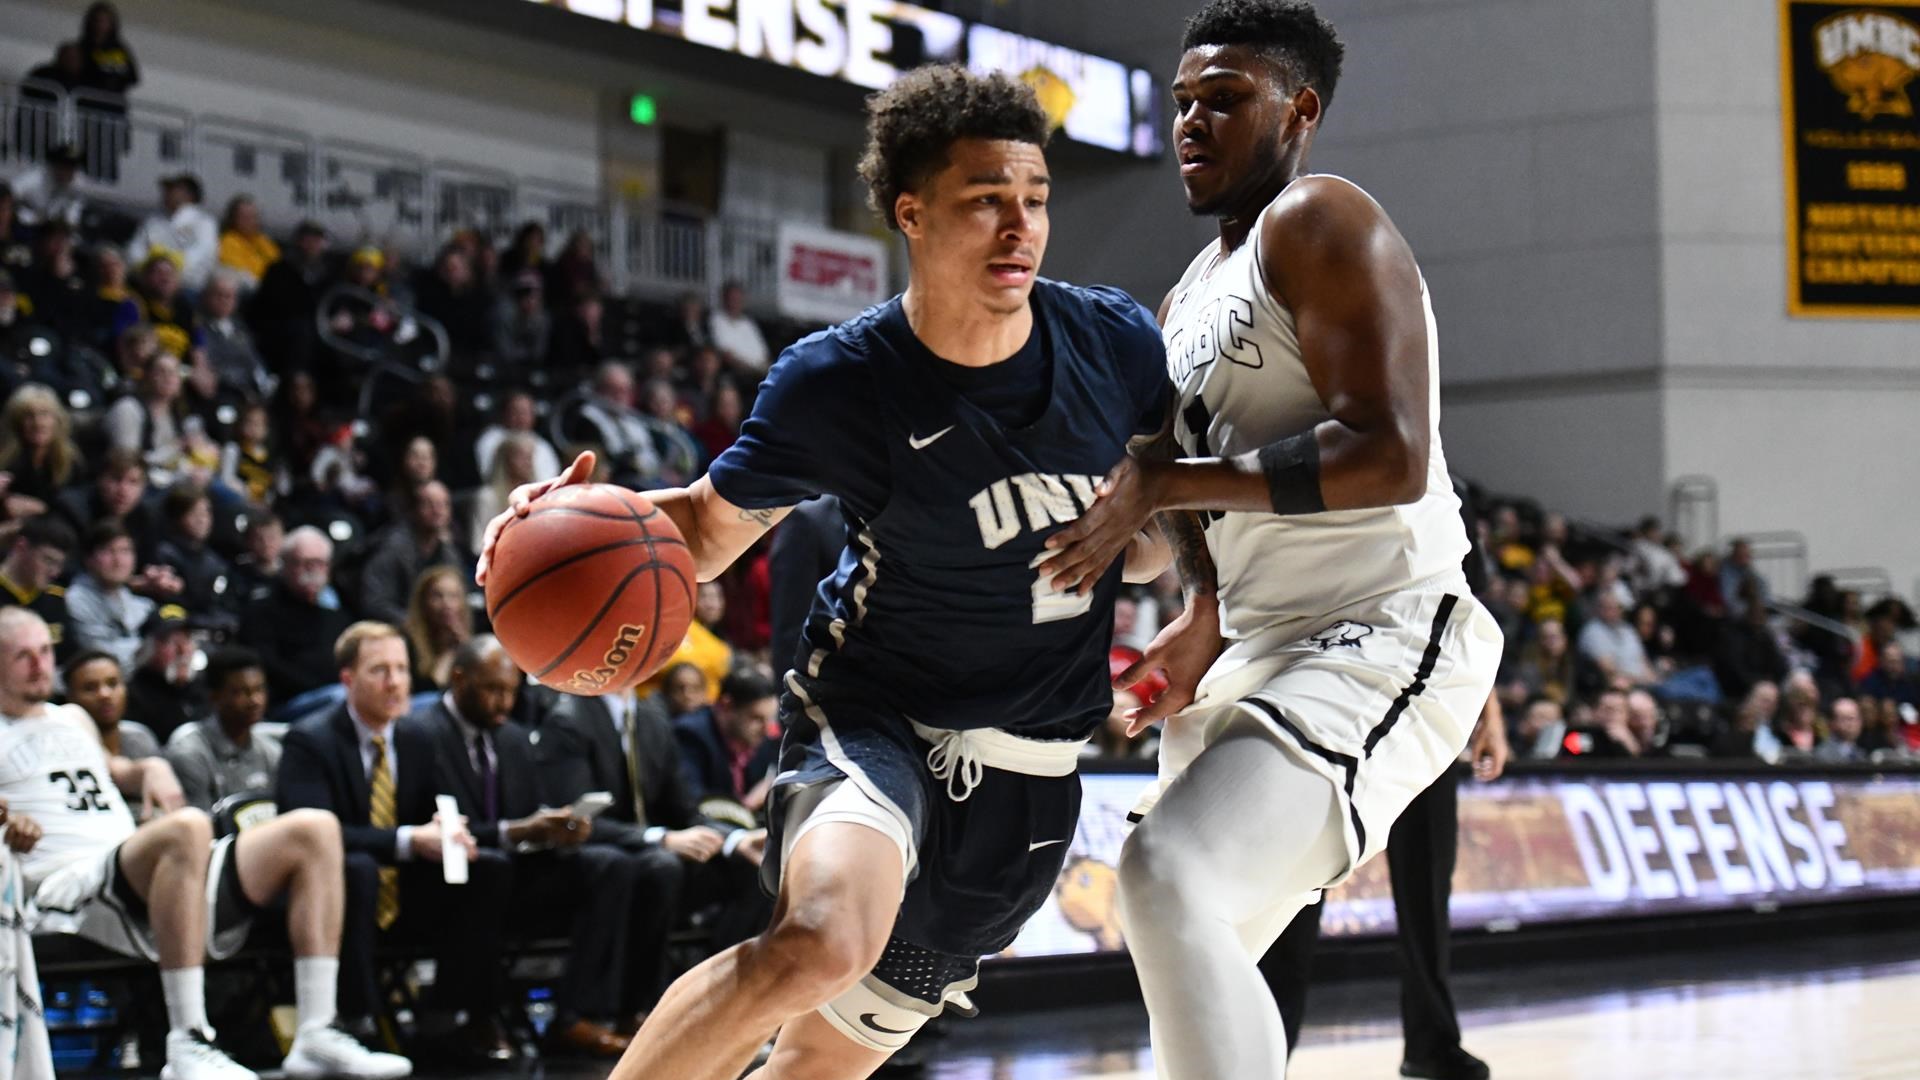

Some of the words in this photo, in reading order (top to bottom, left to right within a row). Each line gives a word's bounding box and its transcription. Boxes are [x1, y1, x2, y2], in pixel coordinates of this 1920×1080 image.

[532, 0, 901, 91] ENSE
[1167, 294, 1263, 384] MBC
[1028, 549, 1094, 624] 2
[562, 624, 645, 692] lson
[48, 769, 111, 811] 32
[1561, 780, 1865, 900] DEFENSE
